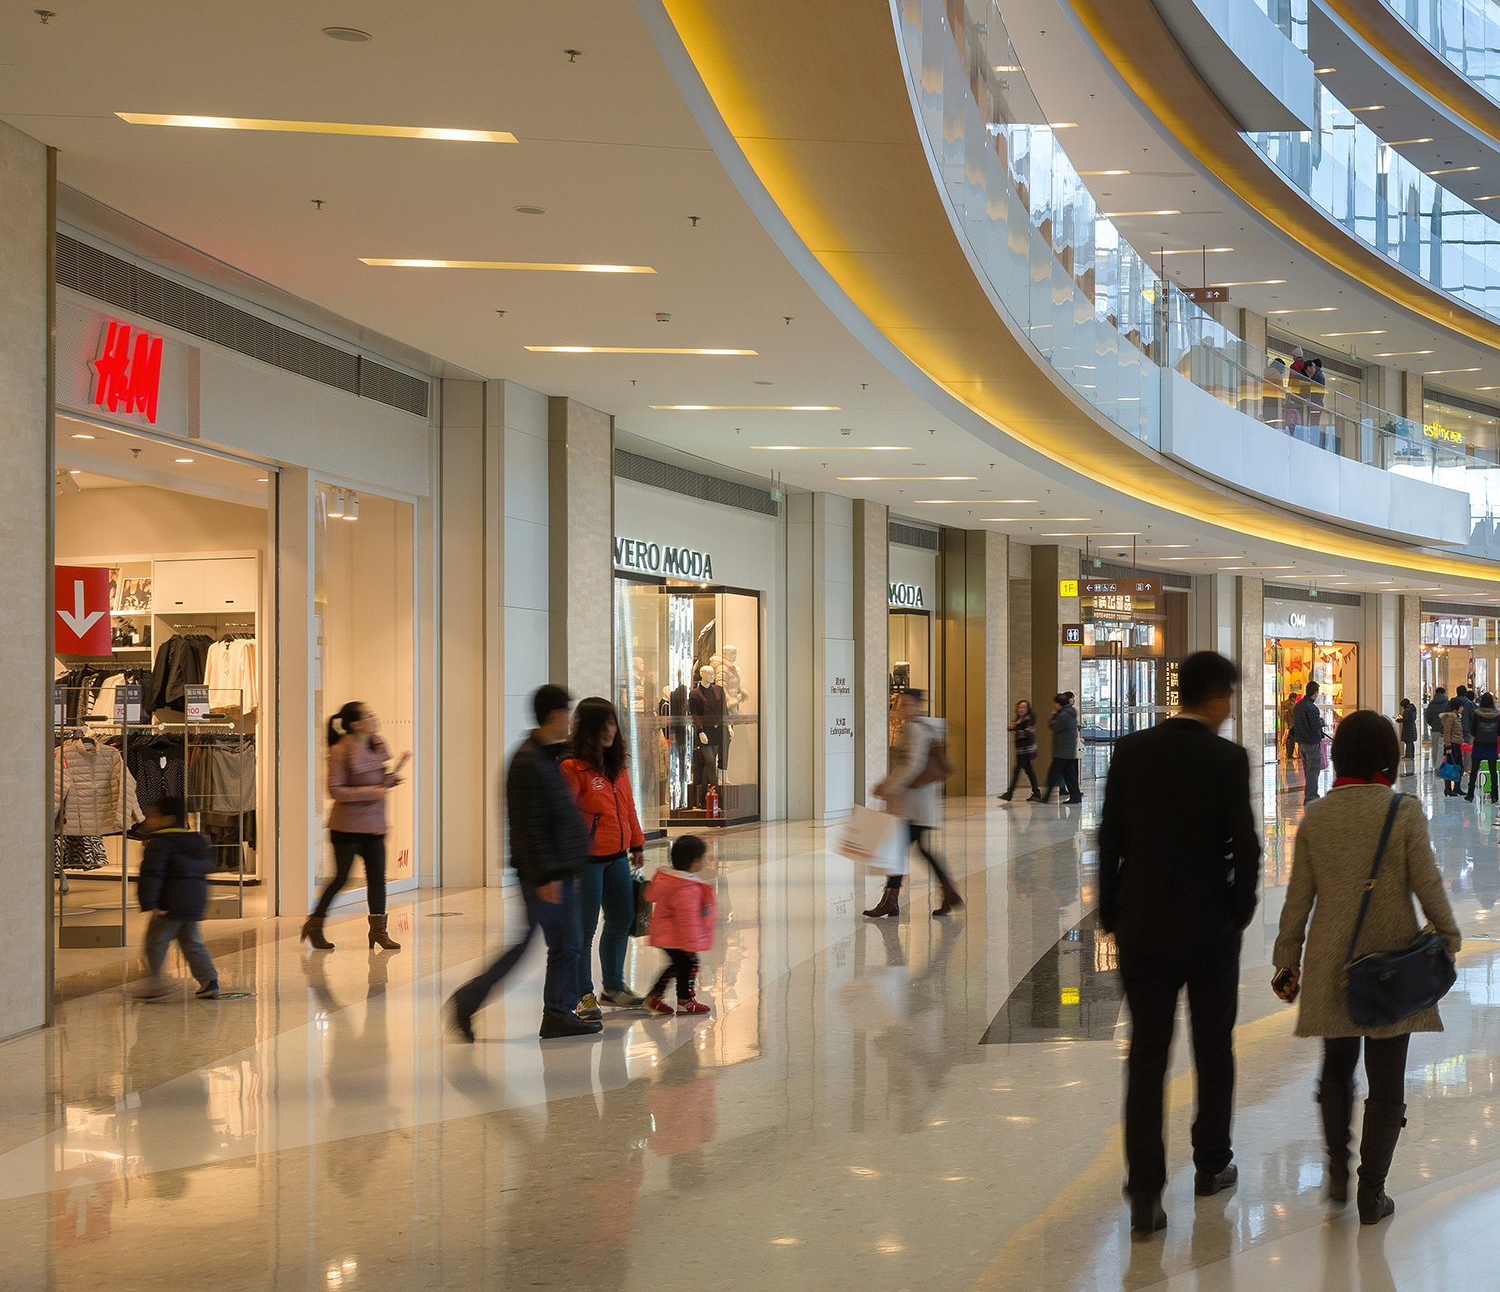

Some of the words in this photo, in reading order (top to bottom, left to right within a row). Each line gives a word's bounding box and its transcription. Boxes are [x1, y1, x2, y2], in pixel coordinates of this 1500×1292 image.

[94, 321, 163, 424] H&M
[614, 536, 660, 571] VERO
[662, 546, 713, 580] MODA
[889, 583, 924, 607] MODA
[1063, 584, 1074, 593] 1F
[1440, 623, 1467, 639] IZOD
